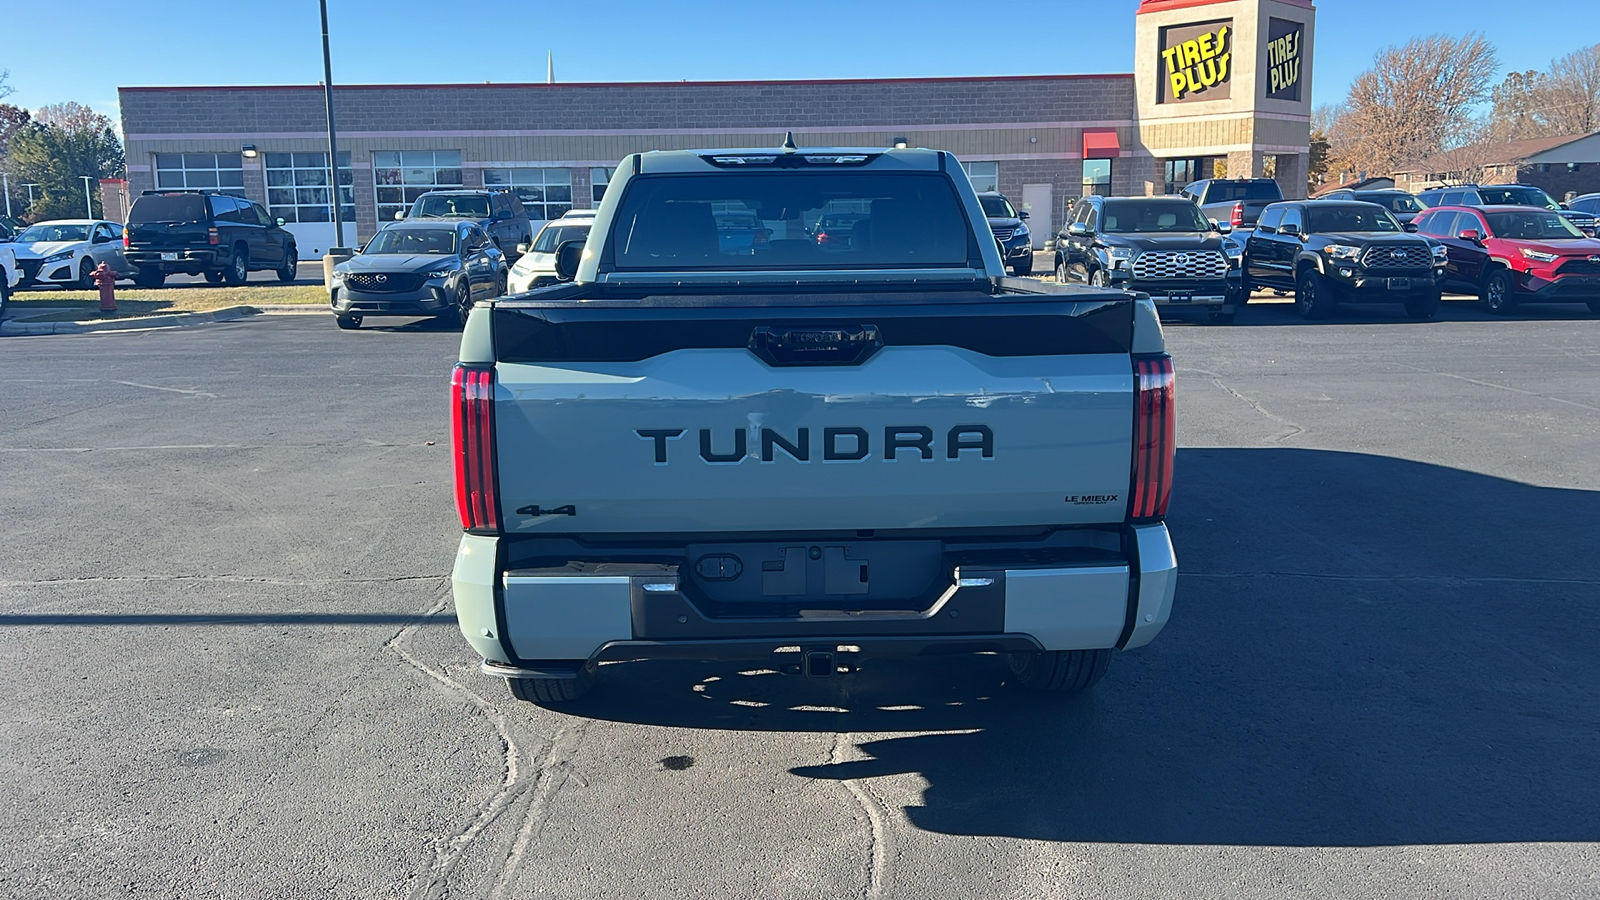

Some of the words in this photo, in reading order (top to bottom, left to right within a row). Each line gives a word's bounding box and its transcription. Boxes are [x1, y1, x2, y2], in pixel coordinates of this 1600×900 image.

[1162, 26, 1228, 74] TIRES
[1267, 30, 1300, 67] TIRES
[1169, 52, 1231, 99] PLUS
[1270, 56, 1300, 94] PLUS
[632, 424, 995, 466] TUNDRA
[1081, 494, 1119, 502] MIEUX
